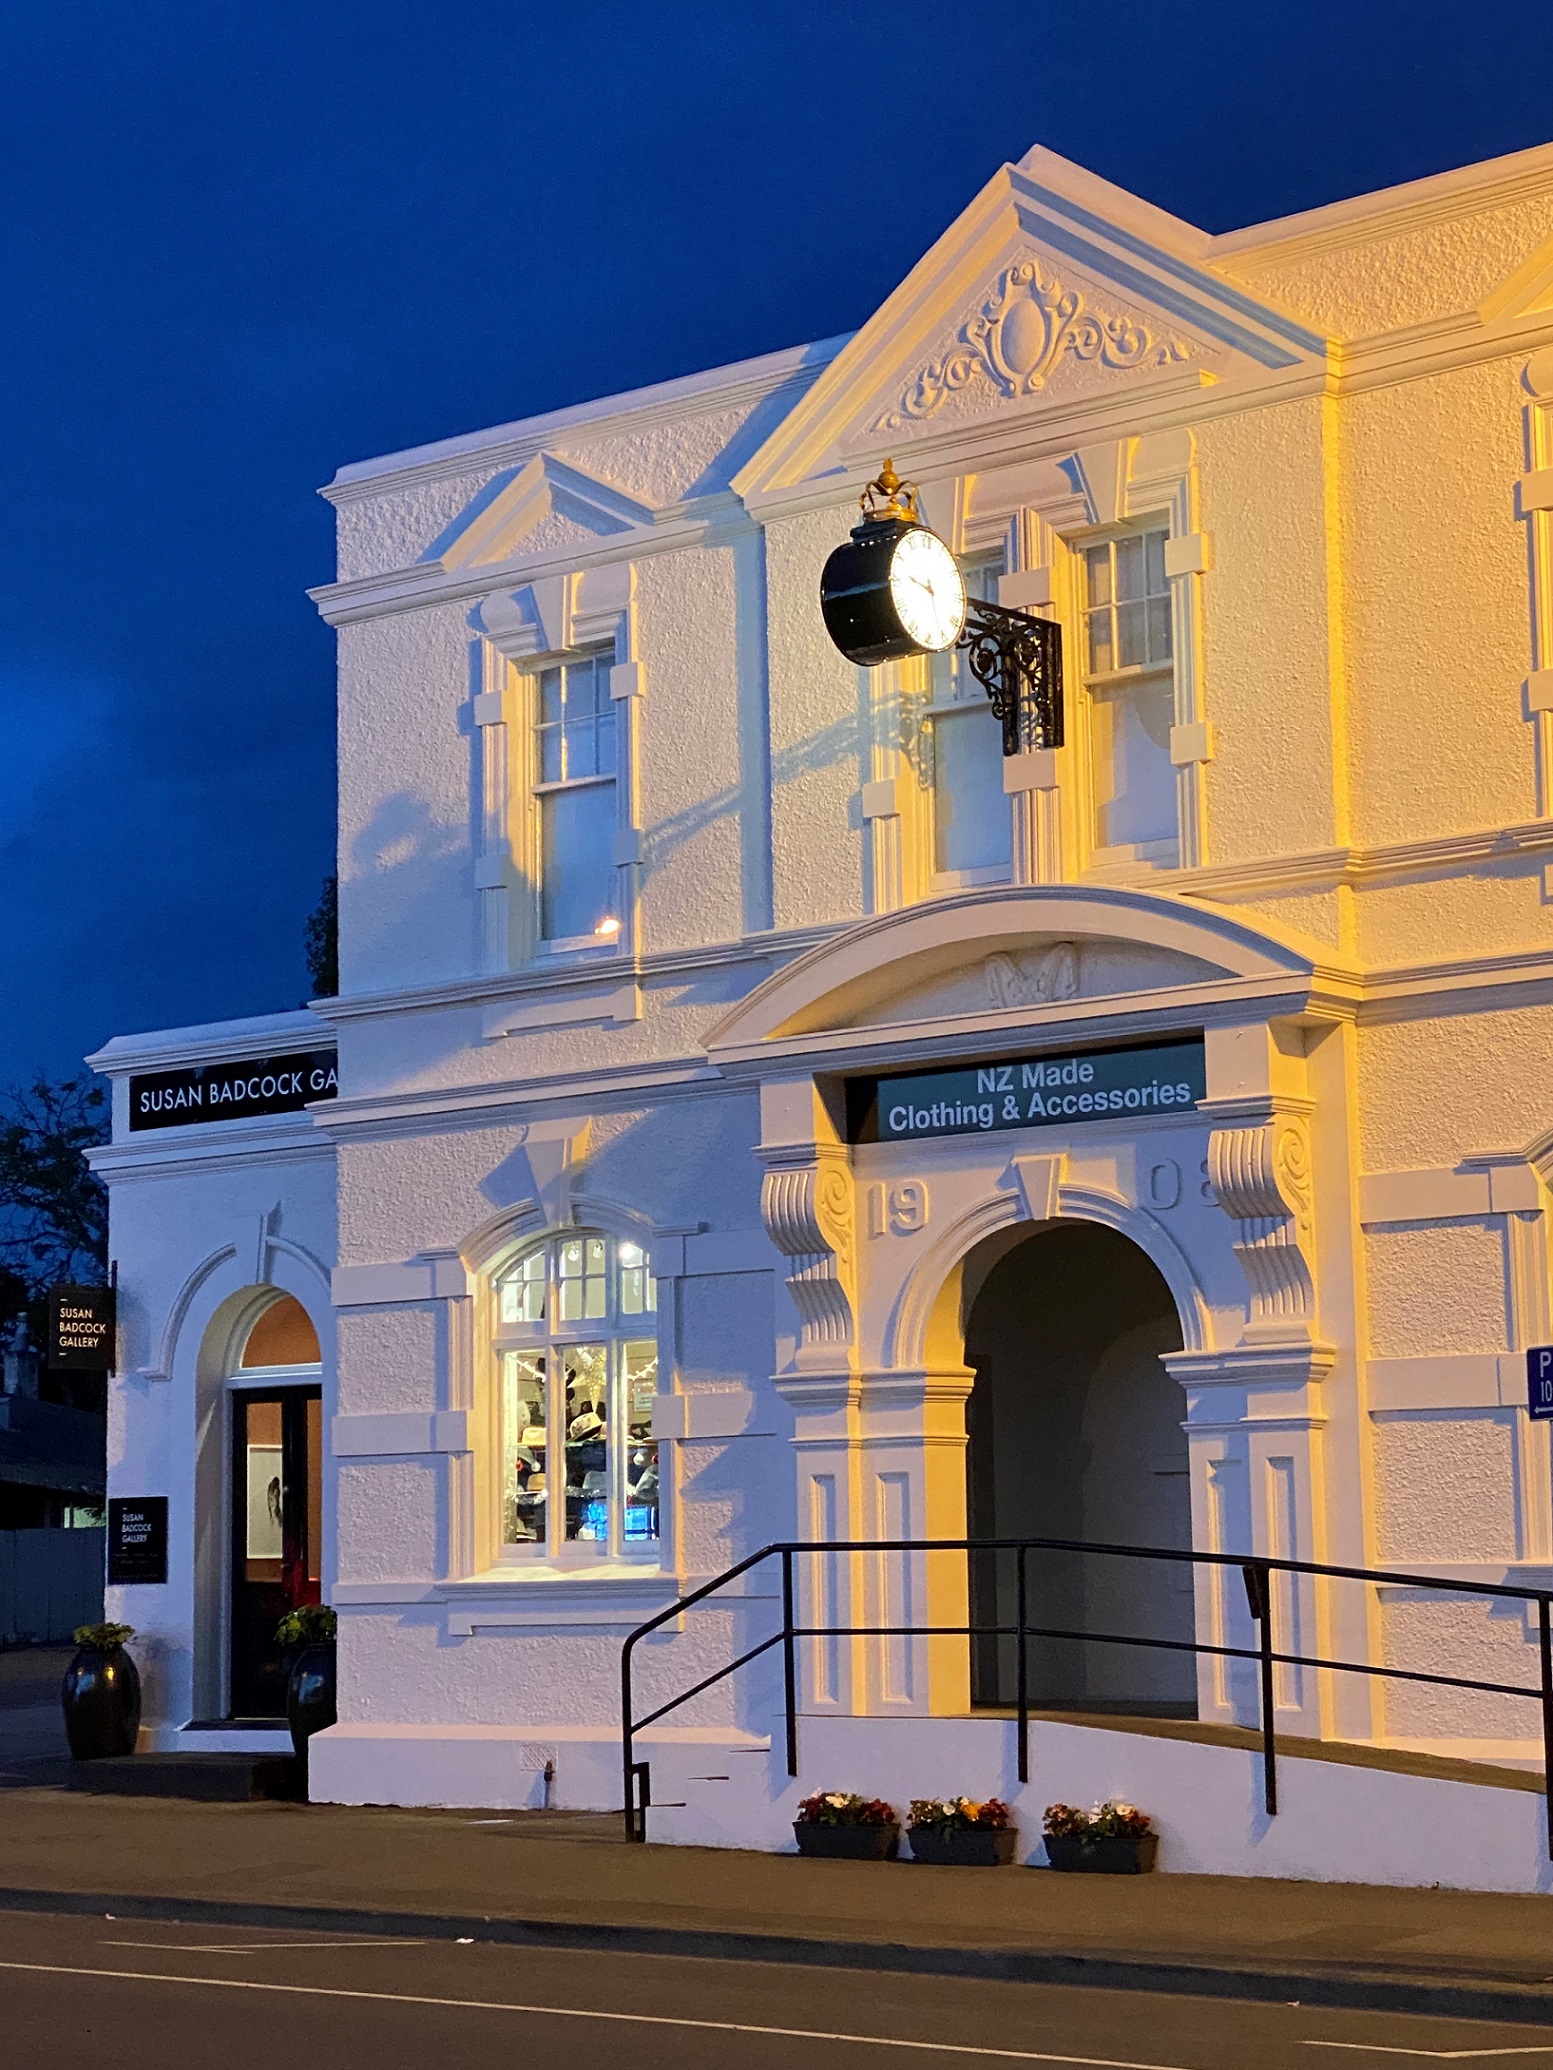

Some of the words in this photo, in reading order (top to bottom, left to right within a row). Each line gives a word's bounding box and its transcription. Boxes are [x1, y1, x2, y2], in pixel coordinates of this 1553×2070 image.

[977, 1066, 1014, 1094] NZ
[1022, 1058, 1094, 1089] Made
[140, 1085, 203, 1113] SUSAN
[209, 1071, 303, 1105] BADCOCK
[888, 1100, 994, 1132] Clothing
[1002, 1095, 1020, 1121] &
[1027, 1080, 1191, 1118] Accessories
[59, 1307, 93, 1319] SUSAN
[59, 1321, 107, 1335] BADCOCK
[58, 1336, 99, 1348] GALLERY
[1539, 1351, 1552, 1378] P
[122, 1513, 144, 1522] SUSAN
[121, 1523, 152, 1533] BADCOCK
[121, 1534, 148, 1543] GALLERY
